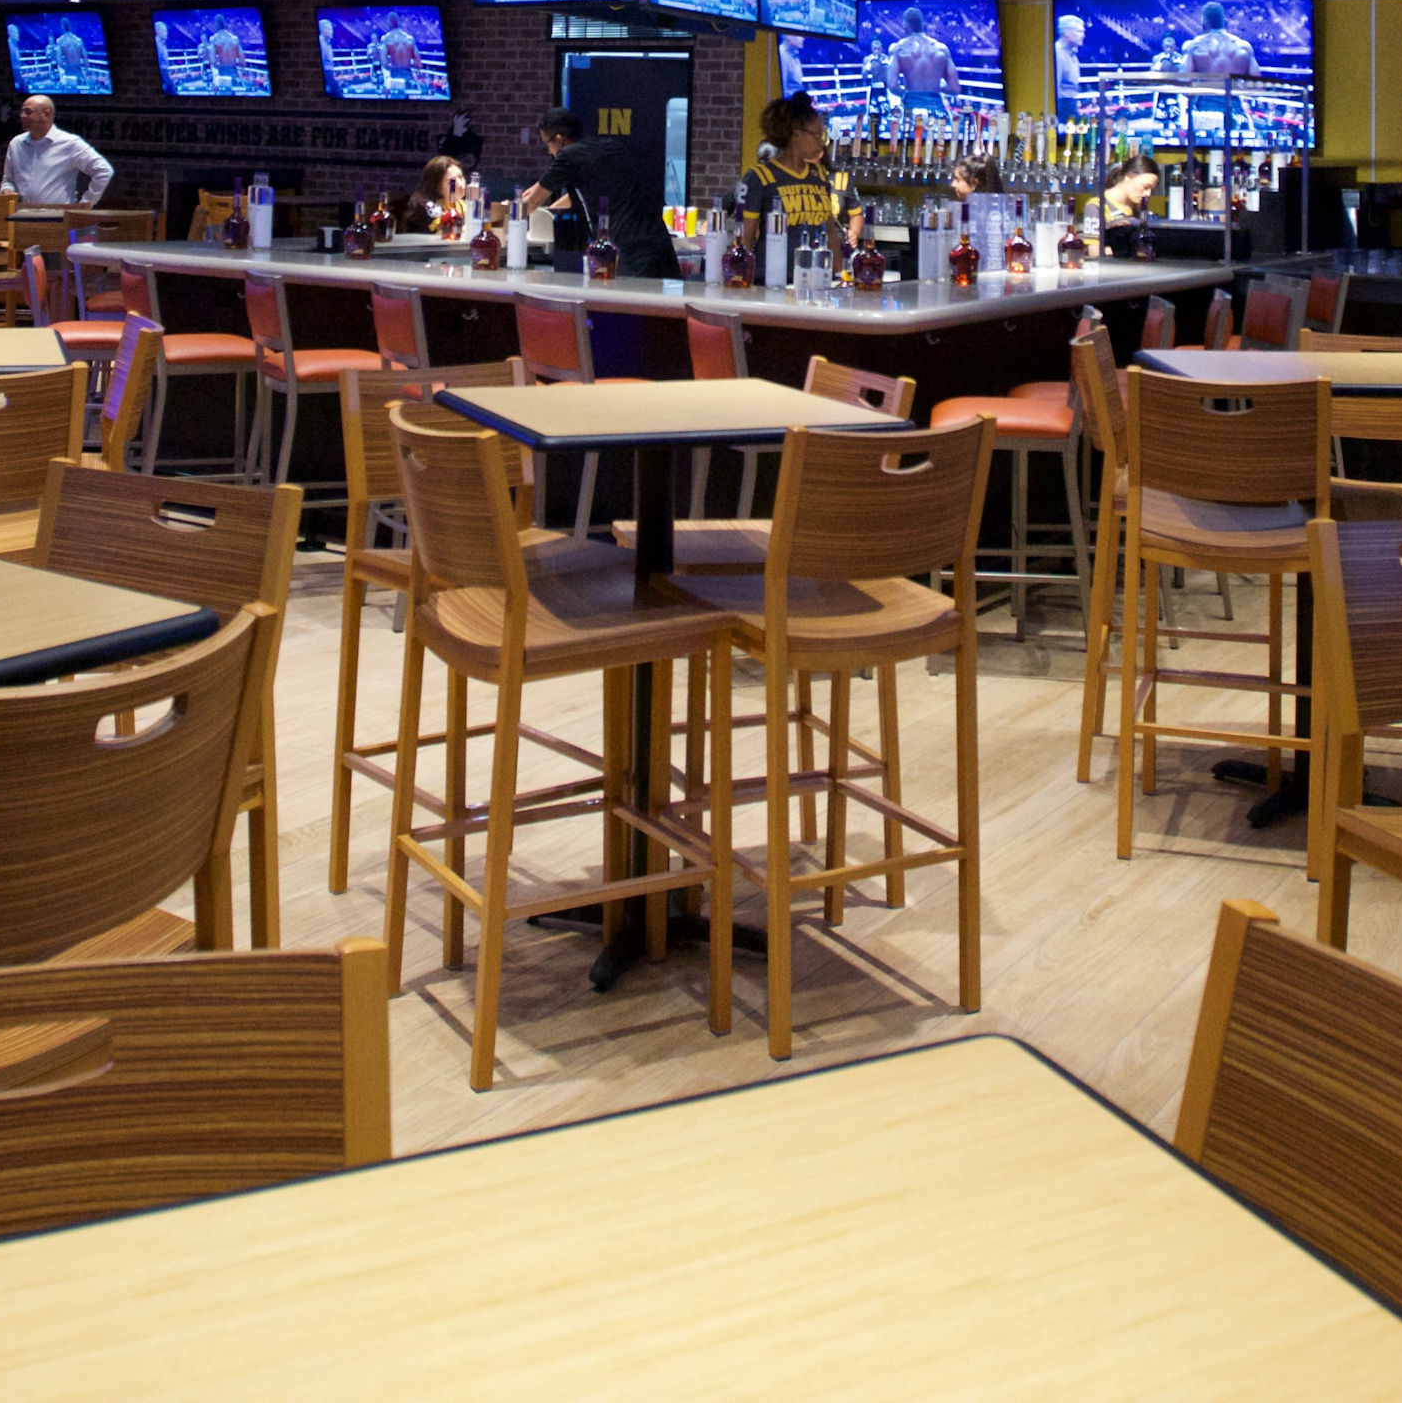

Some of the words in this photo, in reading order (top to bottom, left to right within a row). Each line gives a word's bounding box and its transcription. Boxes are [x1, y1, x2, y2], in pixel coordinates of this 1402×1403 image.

[121, 118, 197, 143] FOREVER
[205, 121, 263, 146] WINGS
[267, 123, 305, 147] ARE
[312, 126, 348, 149] FOR
[355, 127, 430, 152] EATING
[598, 108, 631, 135] IN
[1084, 217, 1100, 235] 82
